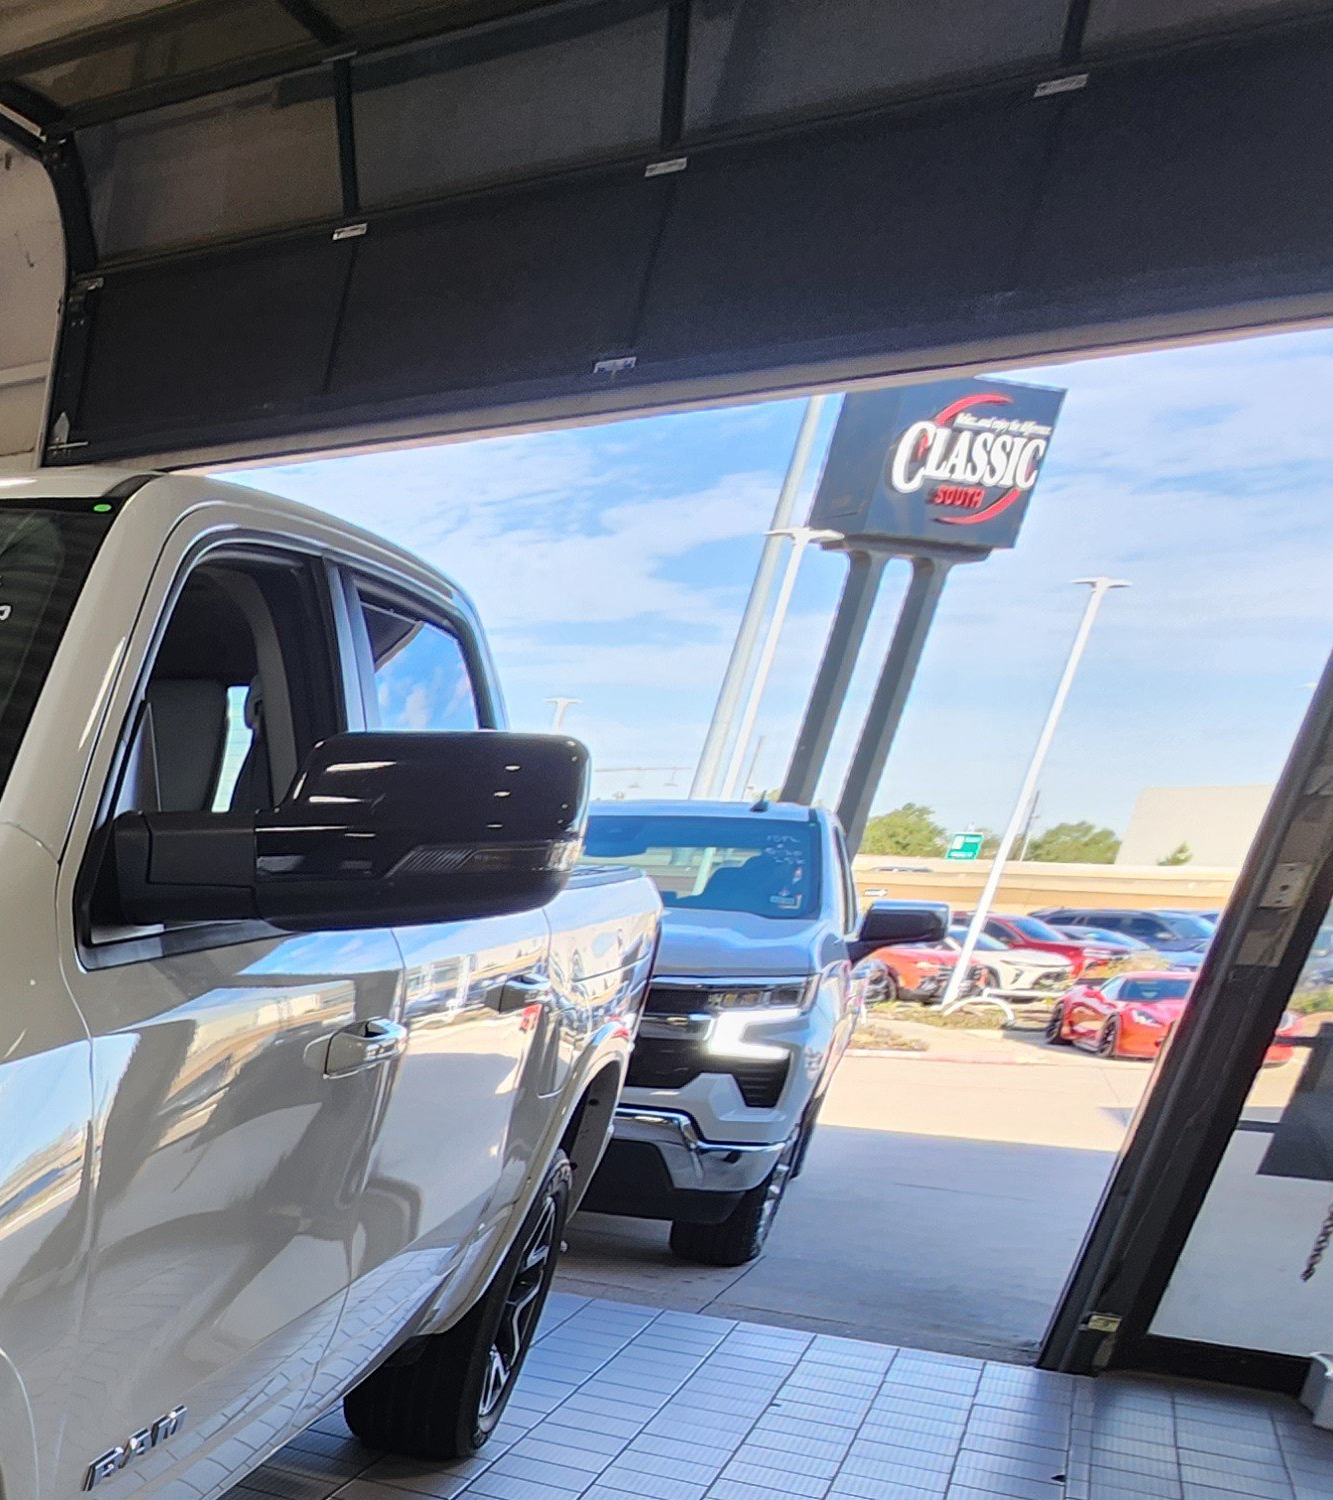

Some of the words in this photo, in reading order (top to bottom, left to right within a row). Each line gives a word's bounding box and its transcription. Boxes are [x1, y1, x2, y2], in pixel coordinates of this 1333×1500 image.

[891, 420, 1047, 493] CLASSIC
[935, 484, 986, 508] SOUTH
[82, 1404, 188, 1492] RAM
